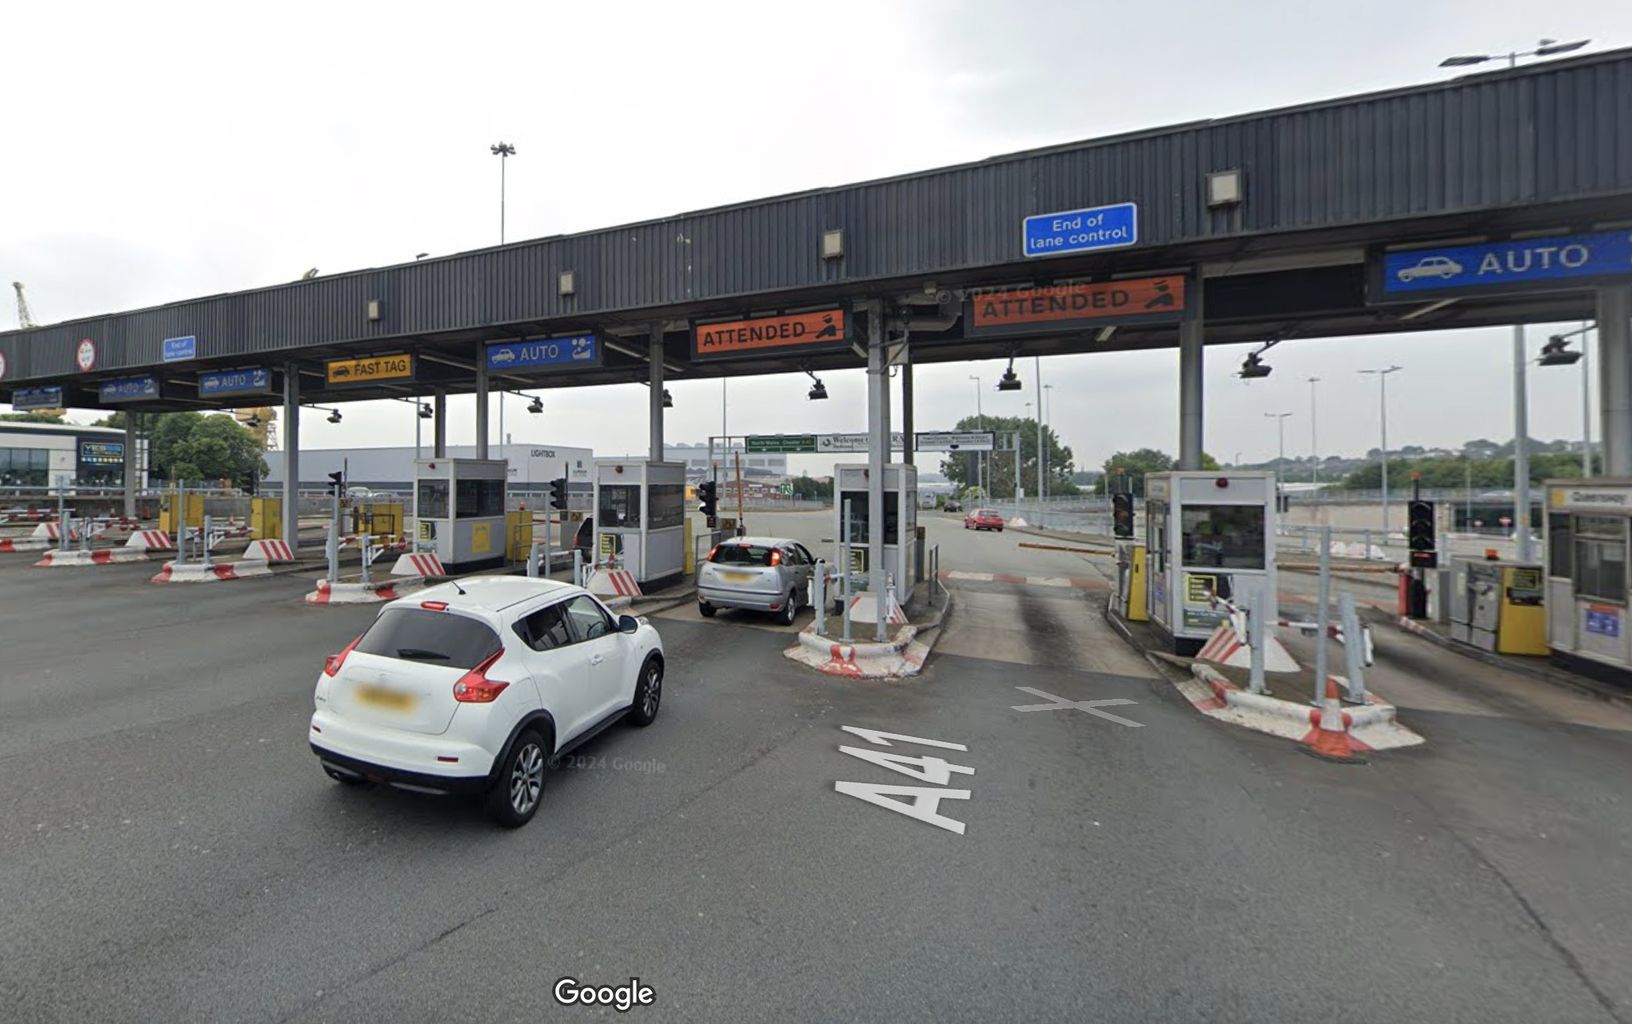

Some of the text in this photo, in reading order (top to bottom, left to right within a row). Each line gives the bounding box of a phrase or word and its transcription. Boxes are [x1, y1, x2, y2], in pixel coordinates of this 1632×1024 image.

[1052, 213, 1104, 232] End of
[1030, 226, 1128, 249] lane control
[1477, 244, 1589, 275] AUTO
[981, 289, 1131, 318] ATTENDED
[703, 322, 806, 347] ATTENDED
[520, 344, 559, 360] AUTO
[354, 359, 407, 376] FAST TAG
[221, 374, 247, 387] AUTO
[833, 436, 864, 444] Welcome
[531, 449, 556, 458] LIGHTBOX
